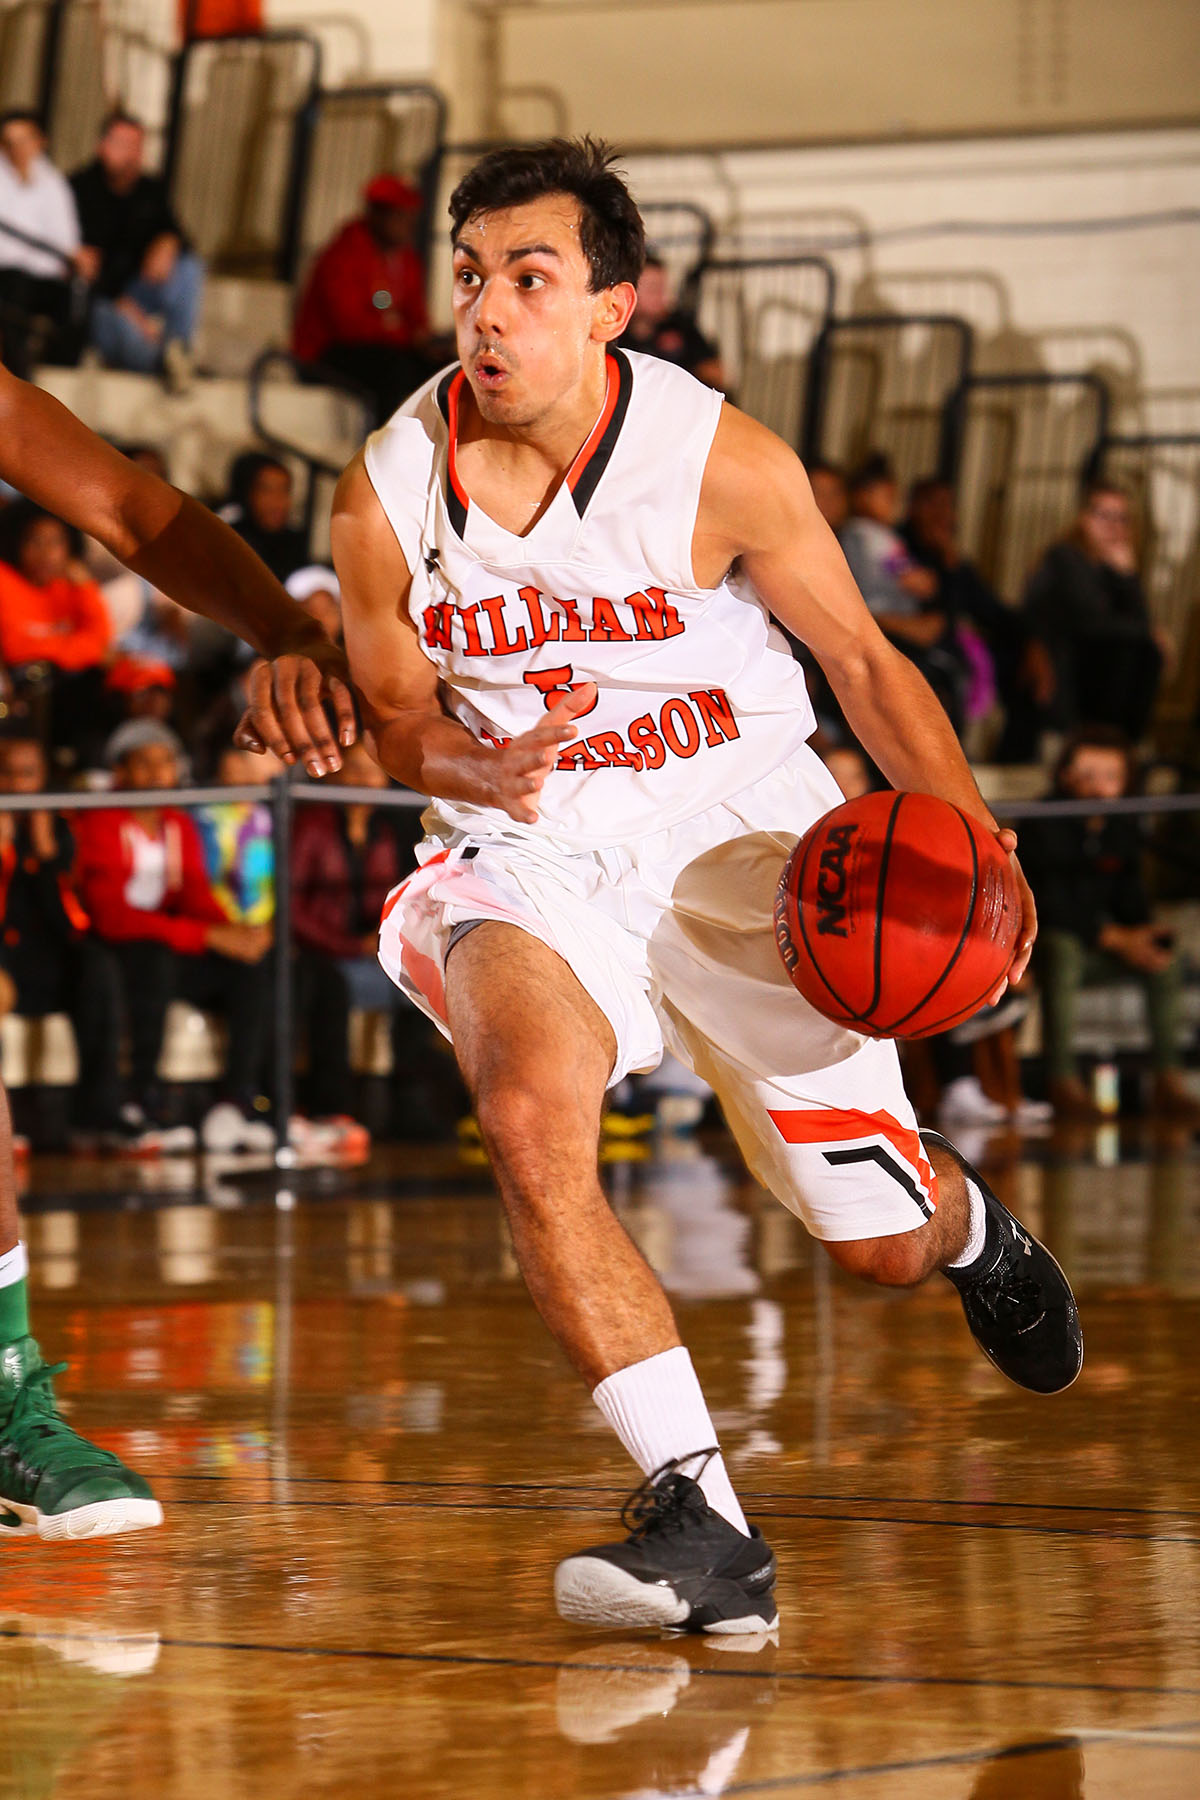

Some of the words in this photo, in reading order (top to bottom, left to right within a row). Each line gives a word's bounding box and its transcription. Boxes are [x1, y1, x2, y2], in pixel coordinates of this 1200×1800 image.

[422, 586, 685, 656] WILLIAM
[523, 664, 598, 720] 5
[816, 824, 859, 938] NCAA
